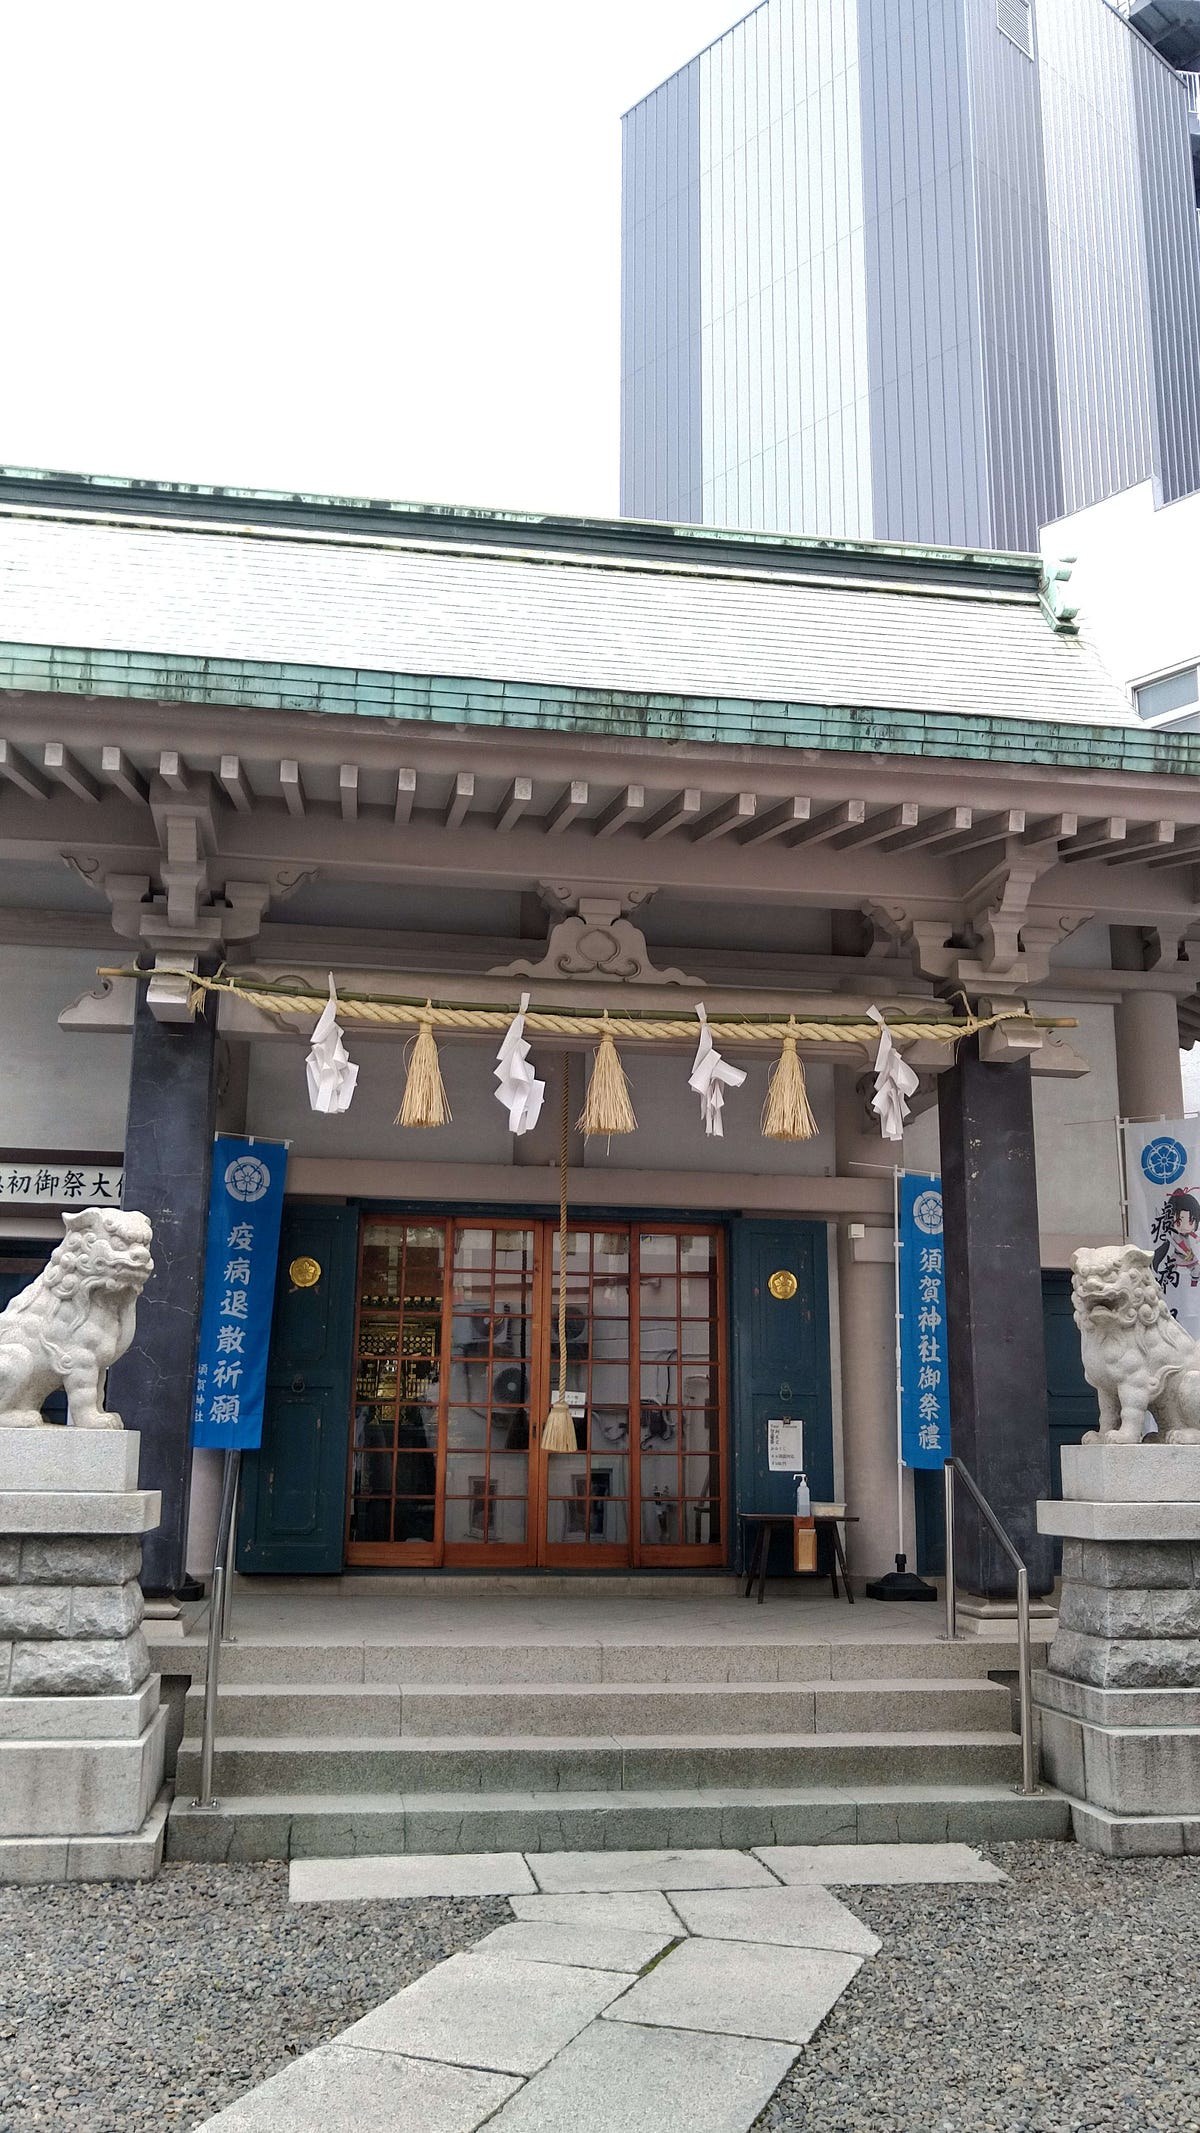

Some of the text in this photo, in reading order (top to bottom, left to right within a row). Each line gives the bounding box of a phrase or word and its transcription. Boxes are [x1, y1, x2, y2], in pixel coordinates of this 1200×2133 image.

[209, 1221, 254, 1424] 疫病退散祈願
[918, 1247, 942, 1451] 須賀神社御祭禮
